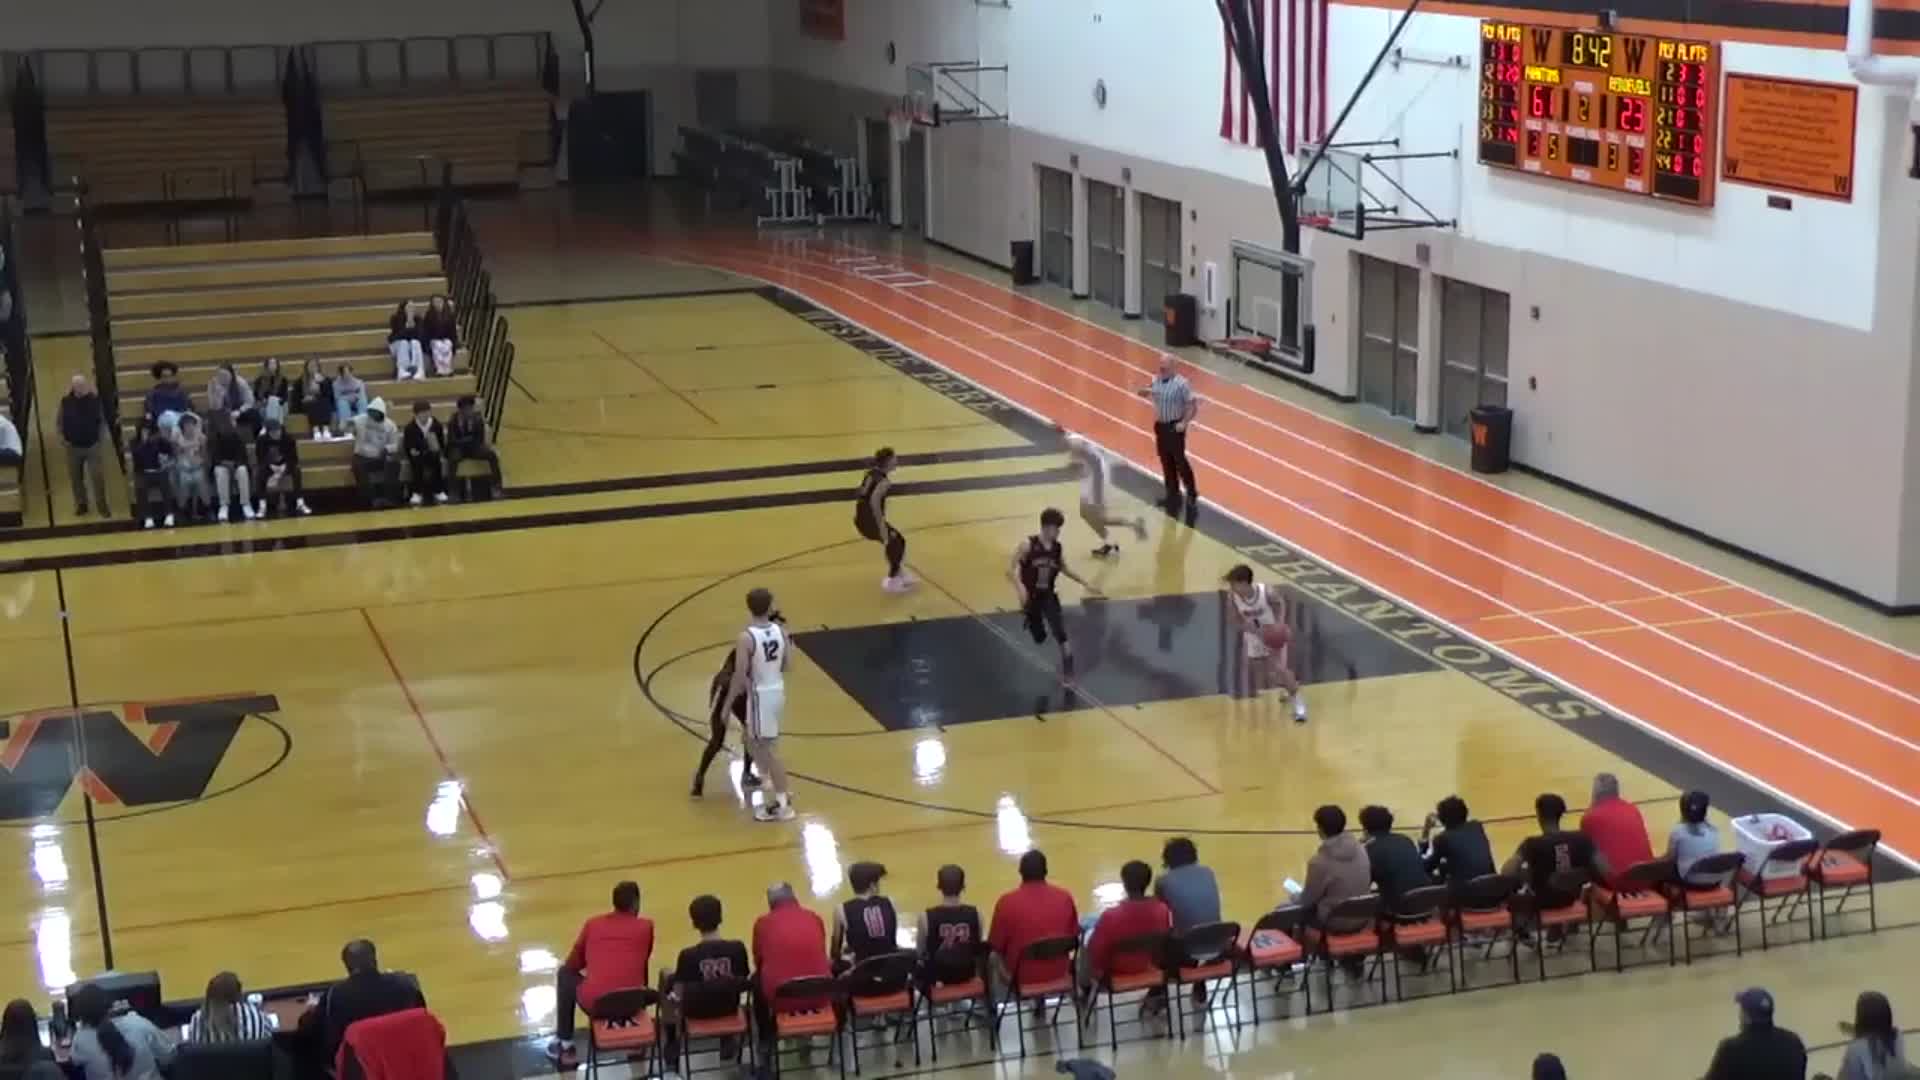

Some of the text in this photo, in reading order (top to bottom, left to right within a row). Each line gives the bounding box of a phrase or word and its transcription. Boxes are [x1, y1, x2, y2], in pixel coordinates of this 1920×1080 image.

[1532, 28, 1552, 62] W
[1623, 37, 1646, 73] W
[1689, 44, 1708, 62] PTS
[1666, 63, 1675, 81] 2
[1679, 64, 1687, 83] 3
[1533, 86, 1554, 116] 61
[1661, 85, 1674, 103] 11
[1578, 95, 1590, 122] 2
[1621, 98, 1645, 131] 23
[1657, 107, 1673, 125] 21
[1548, 134, 1559, 159] 5
[1656, 128, 1673, 149] 22
[1608, 144, 1618, 169] 3
[1833, 175, 1848, 193] W
[1472, 424, 1488, 445] W
[1236, 543, 1603, 721] PHANTOMS
[761, 639, 780, 663] 12
